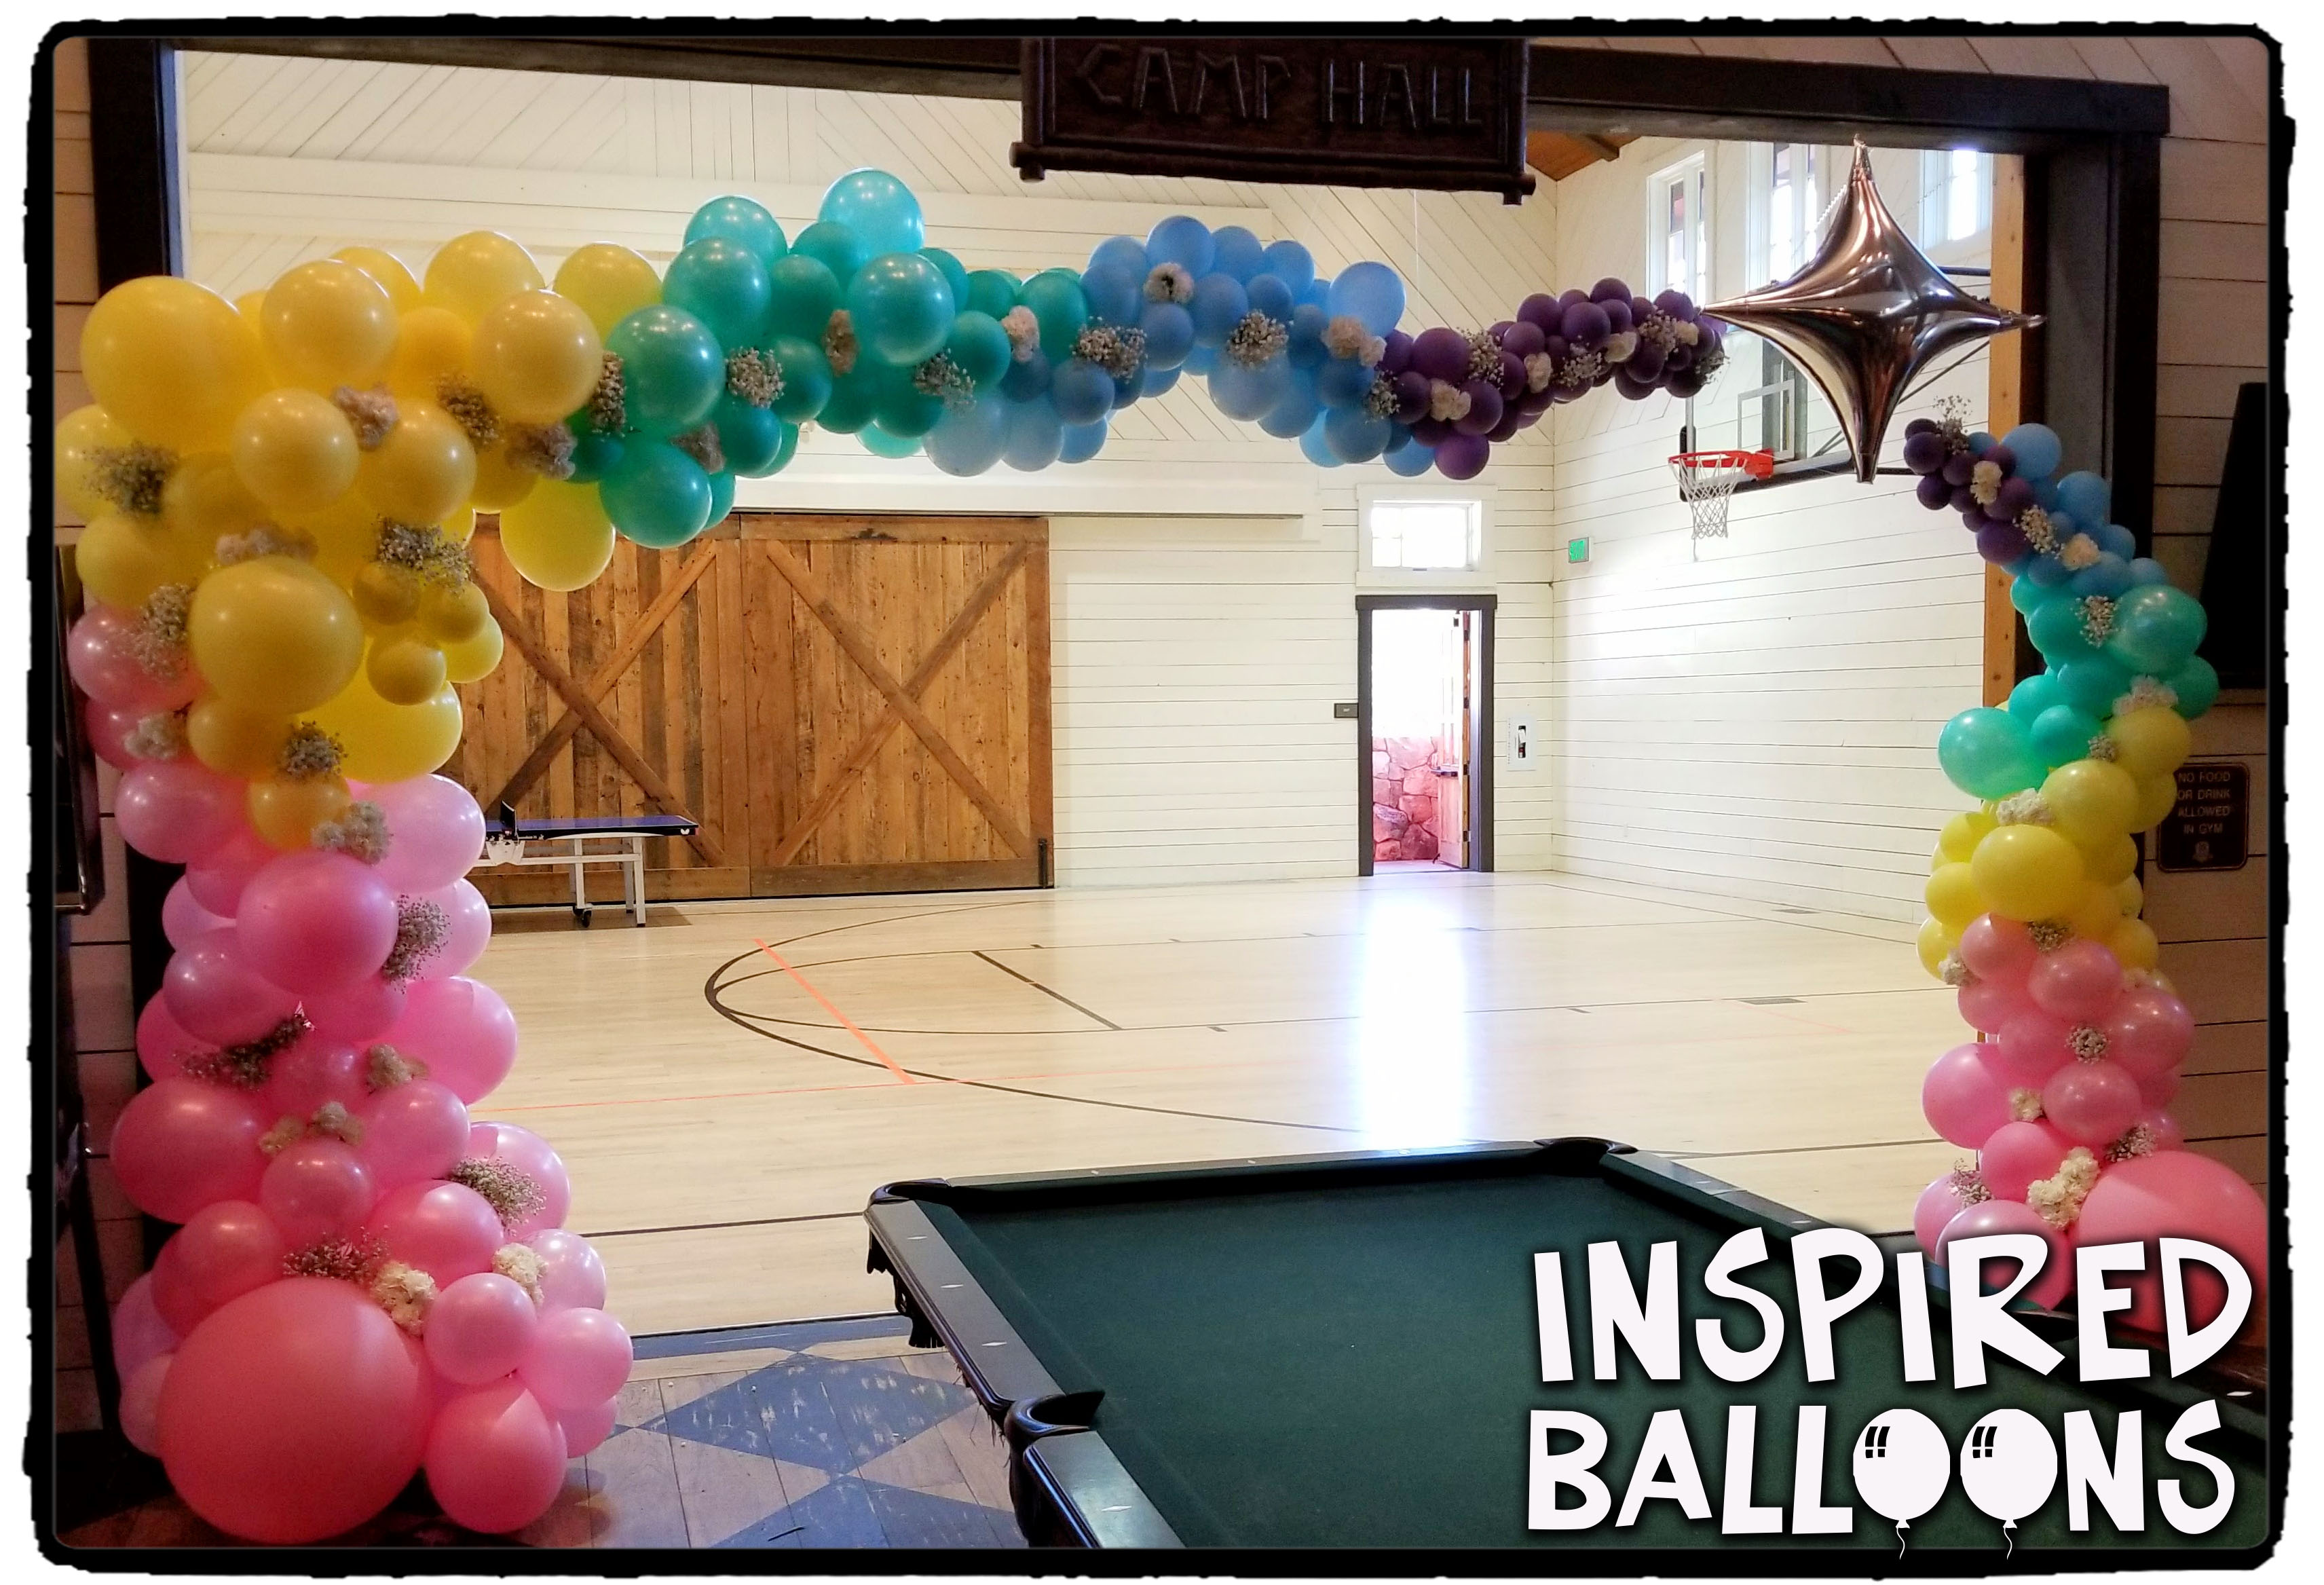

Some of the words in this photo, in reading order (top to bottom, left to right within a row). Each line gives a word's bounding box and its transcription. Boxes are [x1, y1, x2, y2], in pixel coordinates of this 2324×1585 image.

[1077, 43, 1291, 121] CAMP
[1324, 57, 1484, 130] HALL
[2178, 771, 2194, 783] NO
[2199, 770, 2230, 783] FOOD
[2177, 789, 2192, 800] OR
[2198, 789, 2231, 800] DRINK
[2177, 806, 2231, 817] ALLOWED
[2184, 823, 2194, 834] IN
[2199, 823, 2224, 834] GYM
